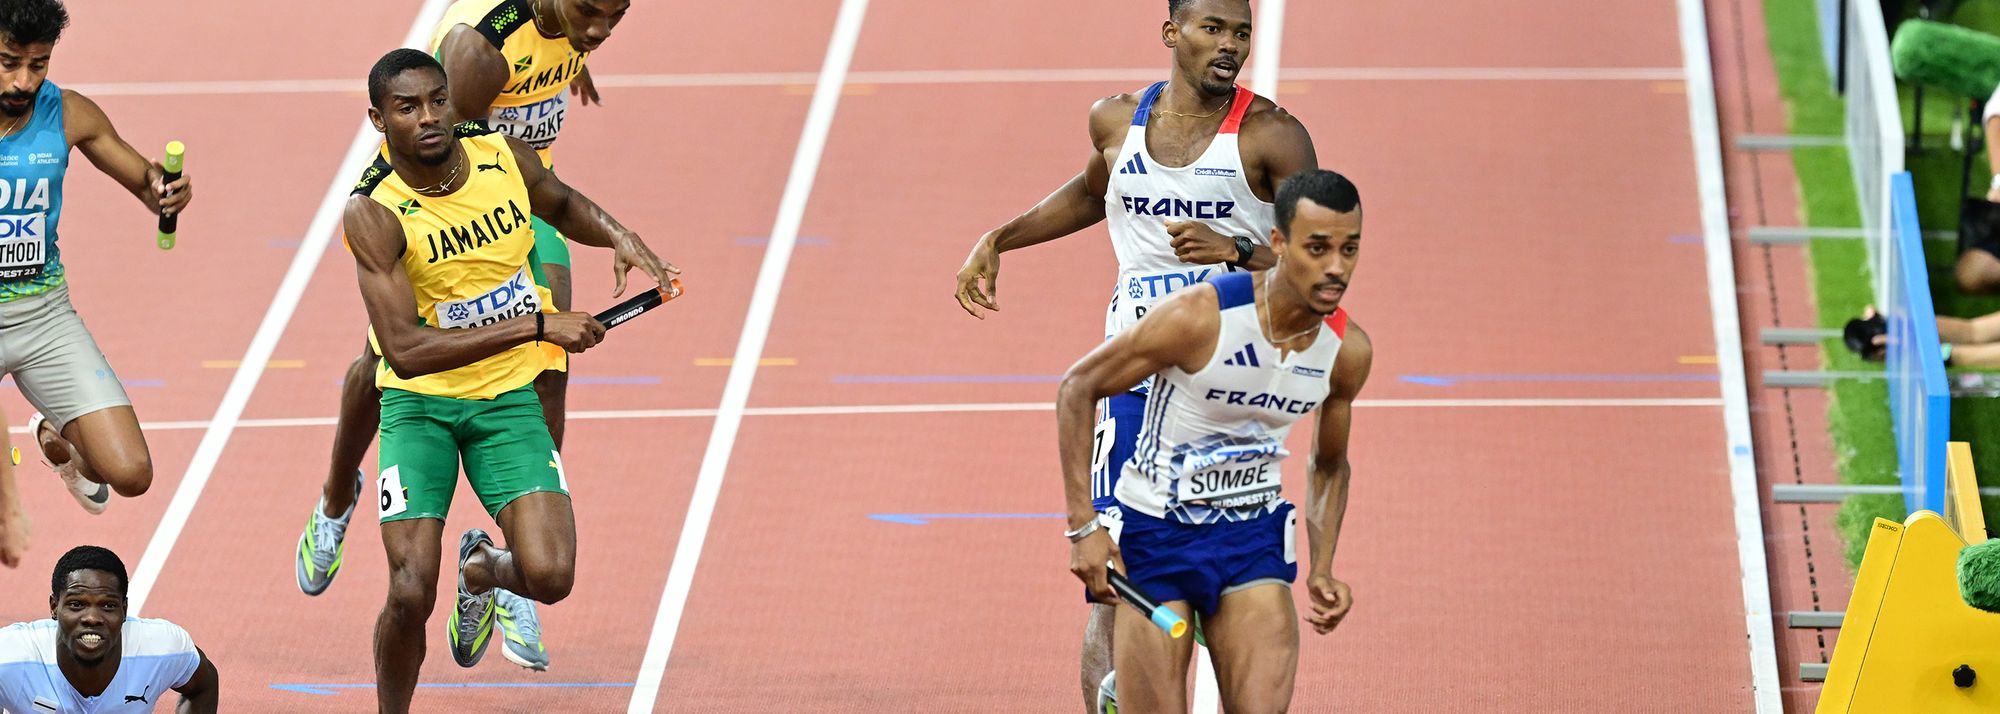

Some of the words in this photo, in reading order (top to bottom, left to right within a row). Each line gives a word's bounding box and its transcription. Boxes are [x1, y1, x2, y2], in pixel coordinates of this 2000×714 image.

[1121, 195, 1235, 219] FRANCE
[427, 199, 527, 264] JAMAICA
[467, 271, 526, 315] TDK
[1140, 268, 1212, 298] TDK
[380, 477, 392, 512] 6
[1190, 461, 1270, 495] SOMBE
